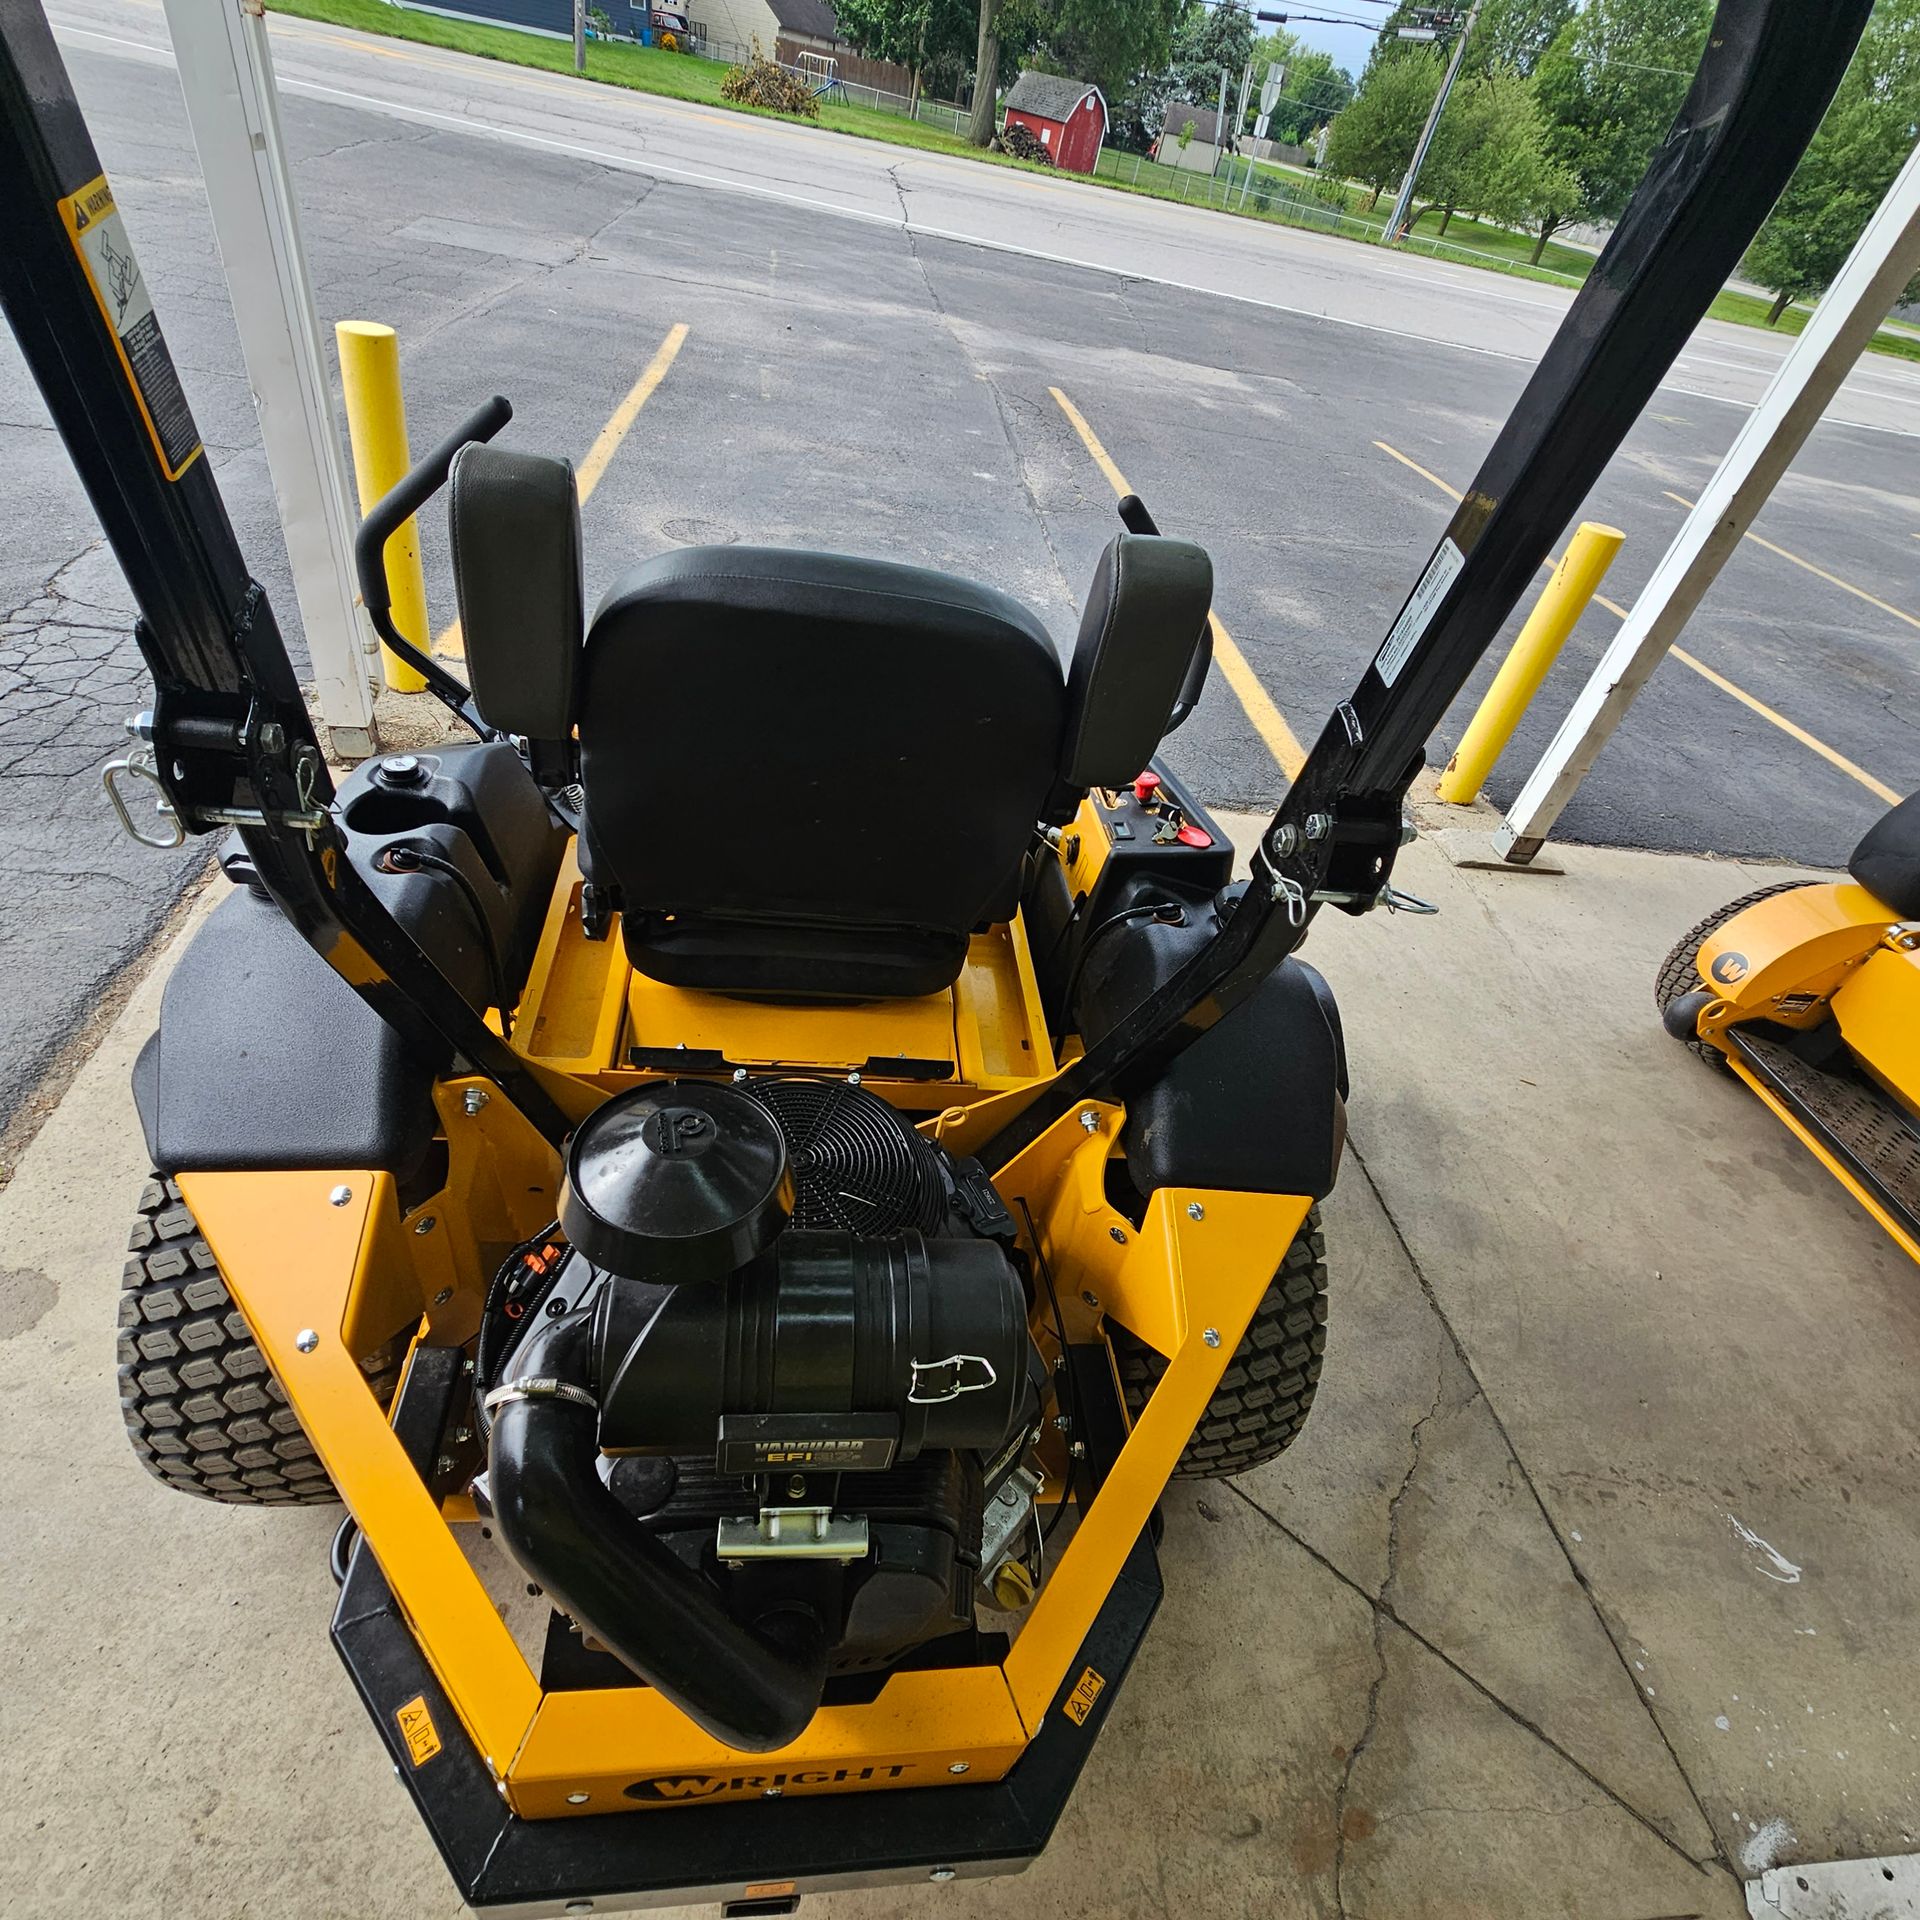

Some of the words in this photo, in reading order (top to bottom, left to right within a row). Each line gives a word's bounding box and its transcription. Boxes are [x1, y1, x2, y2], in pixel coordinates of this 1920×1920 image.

[755, 1440, 864, 1452] VANGUARD
[767, 1452, 813, 1463] EFI
[652, 1764, 917, 1799] WRIGHT
